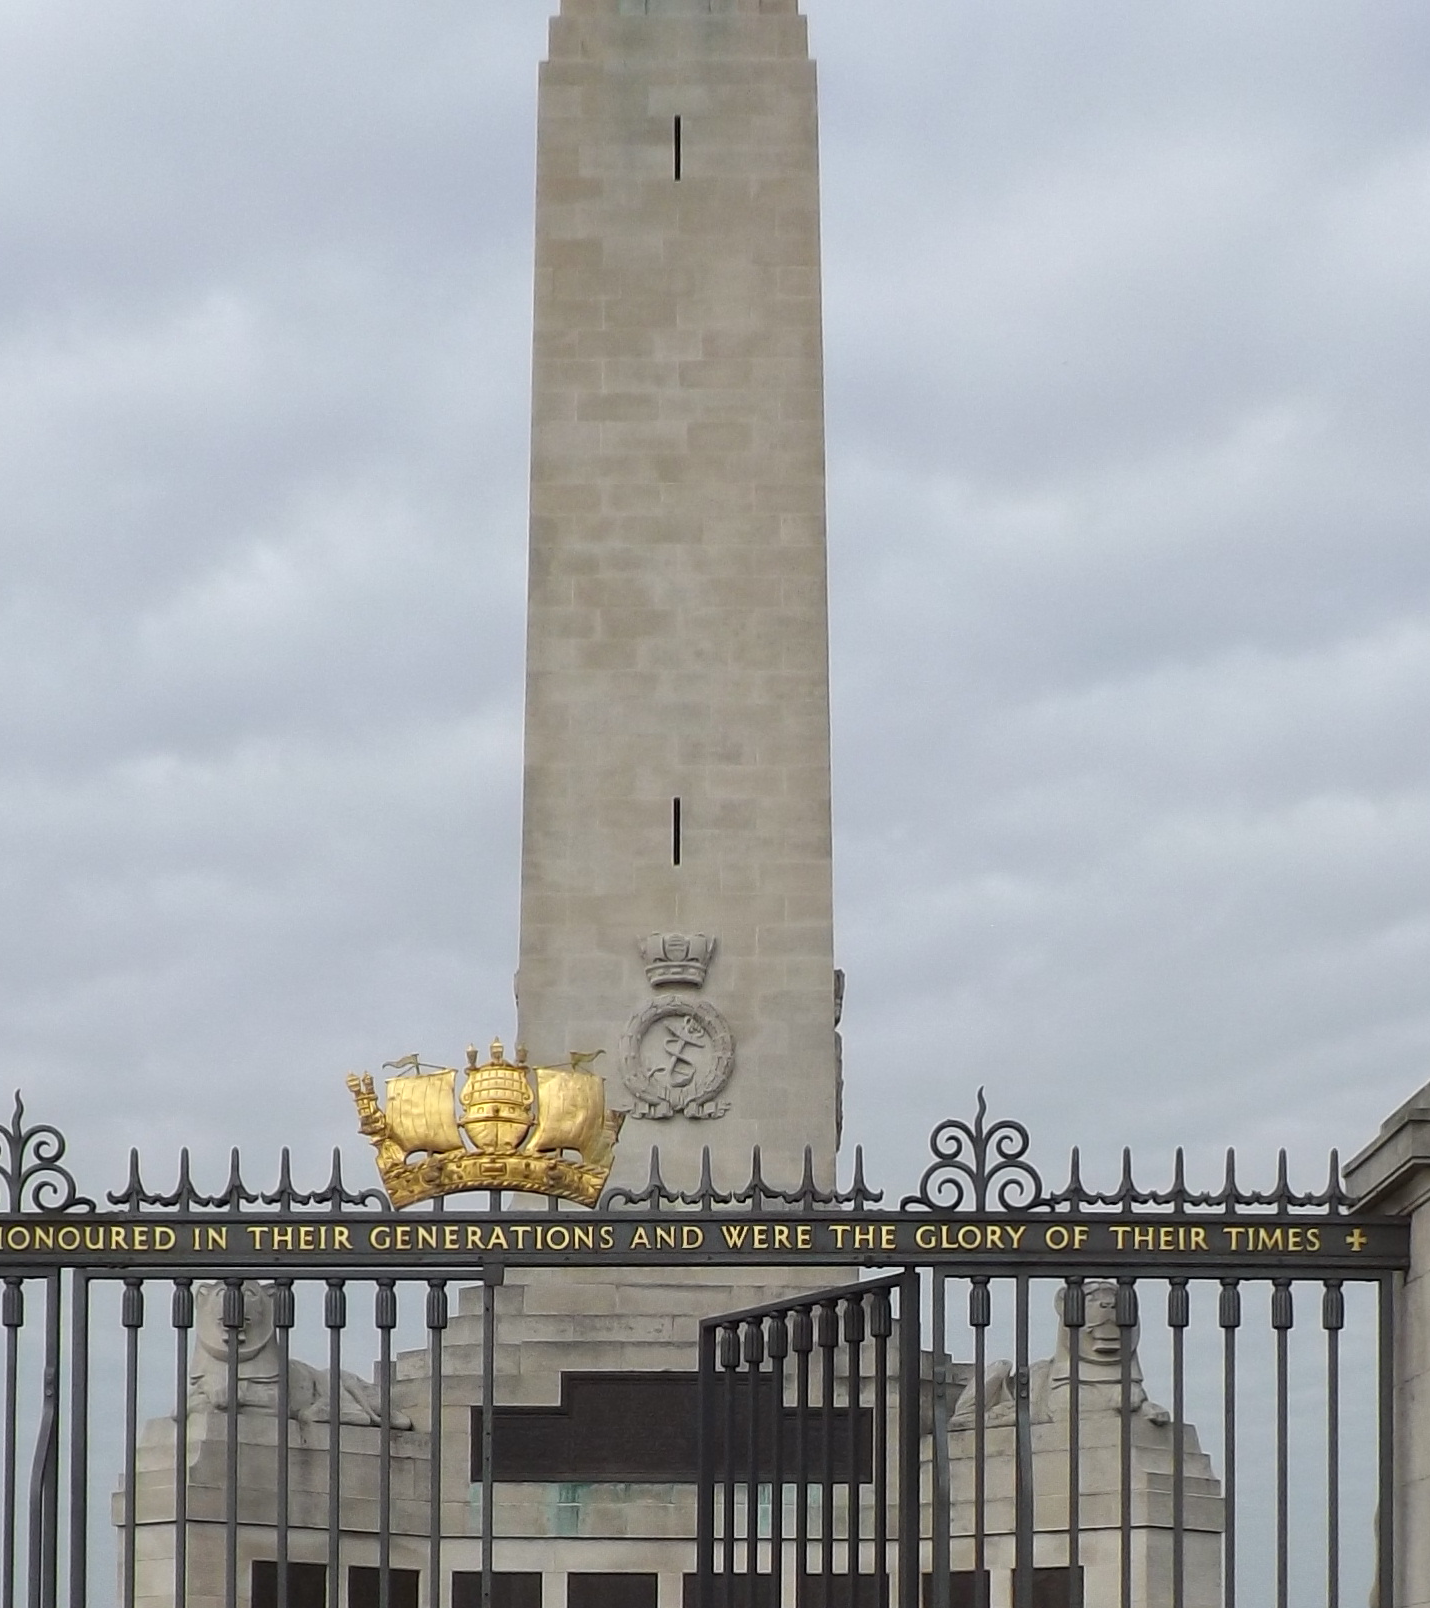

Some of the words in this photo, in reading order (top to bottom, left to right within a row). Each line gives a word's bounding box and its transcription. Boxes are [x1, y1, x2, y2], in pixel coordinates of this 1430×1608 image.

[193, 1227, 228, 1250] IN
[247, 1225, 351, 1250] THEIR
[369, 1225, 614, 1250] GENERATIONS
[631, 1225, 704, 1249] AND
[722, 1225, 811, 1249] WERE
[829, 1225, 896, 1249] THE
[916, 1225, 1027, 1250] GLORY
[1045, 1226, 1087, 1249] OF
[1109, 1226, 1209, 1250] THEIR
[1225, 1227, 1322, 1251] TIMES
